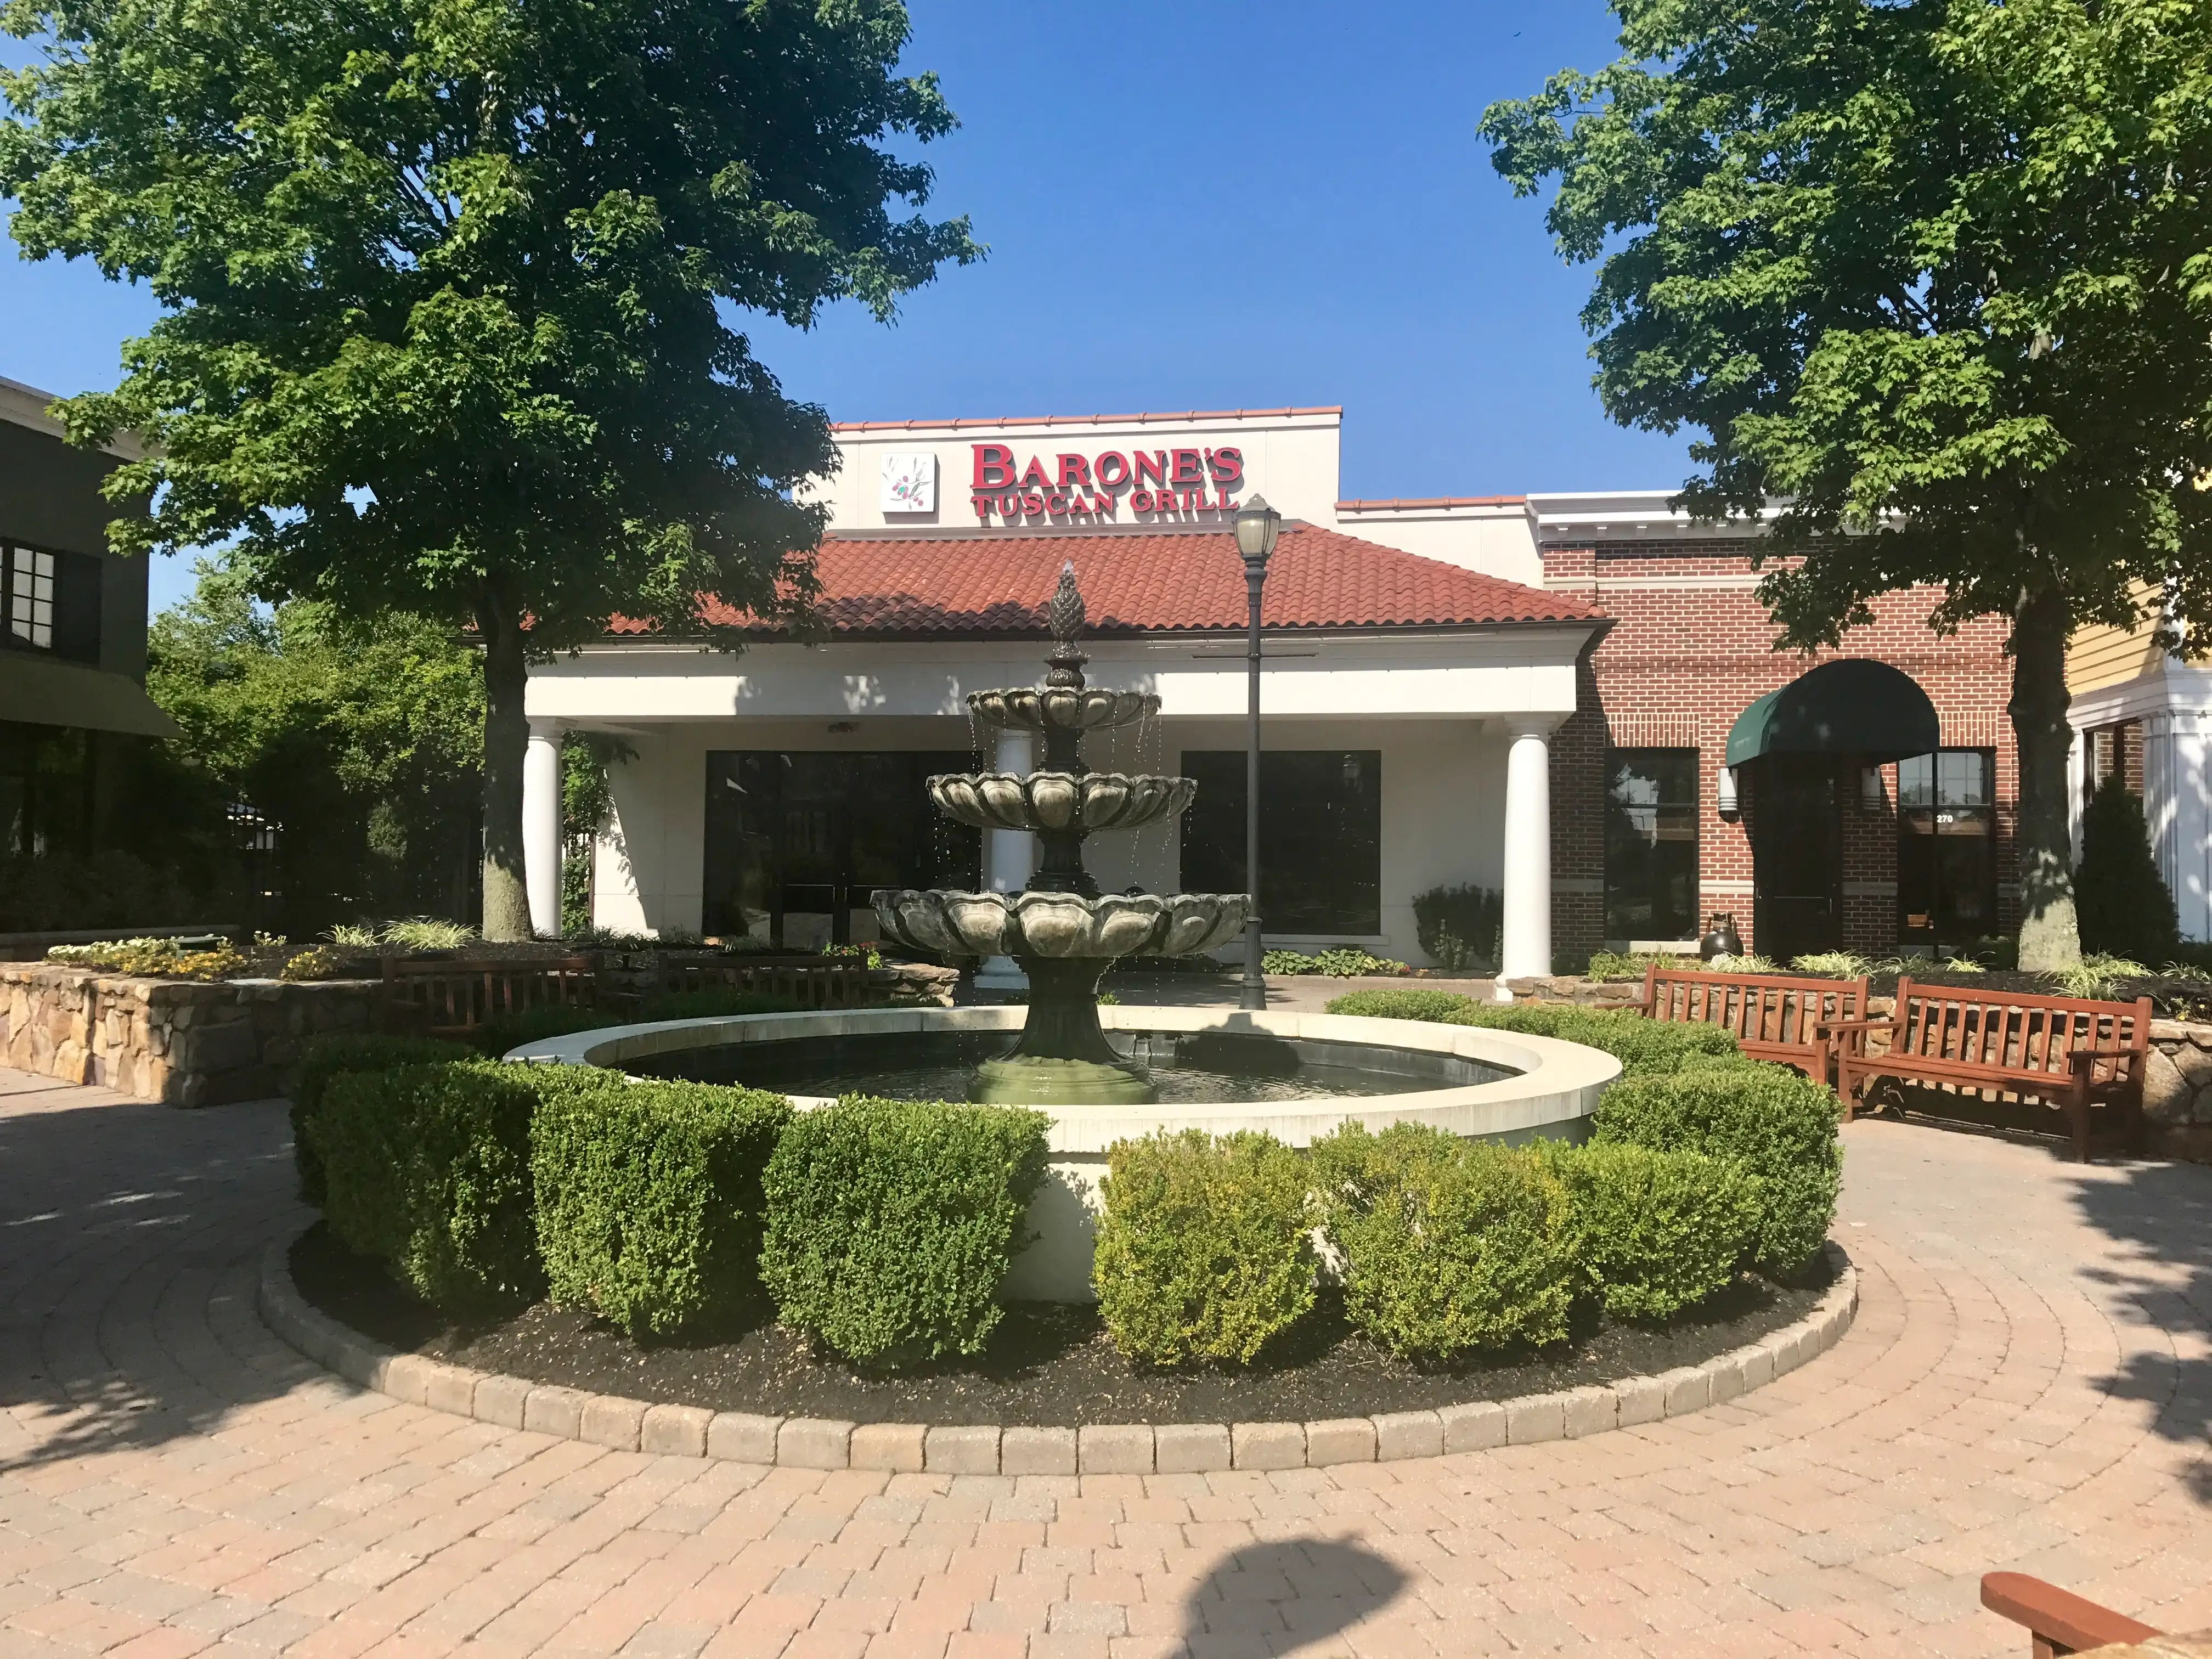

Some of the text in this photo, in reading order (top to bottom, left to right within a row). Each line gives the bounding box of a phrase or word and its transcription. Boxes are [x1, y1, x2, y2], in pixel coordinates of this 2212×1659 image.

[969, 444, 1241, 489] BARONE'S
[970, 488, 1239, 517] TUSCAN GRILL
[1937, 815, 1953, 823] 270
